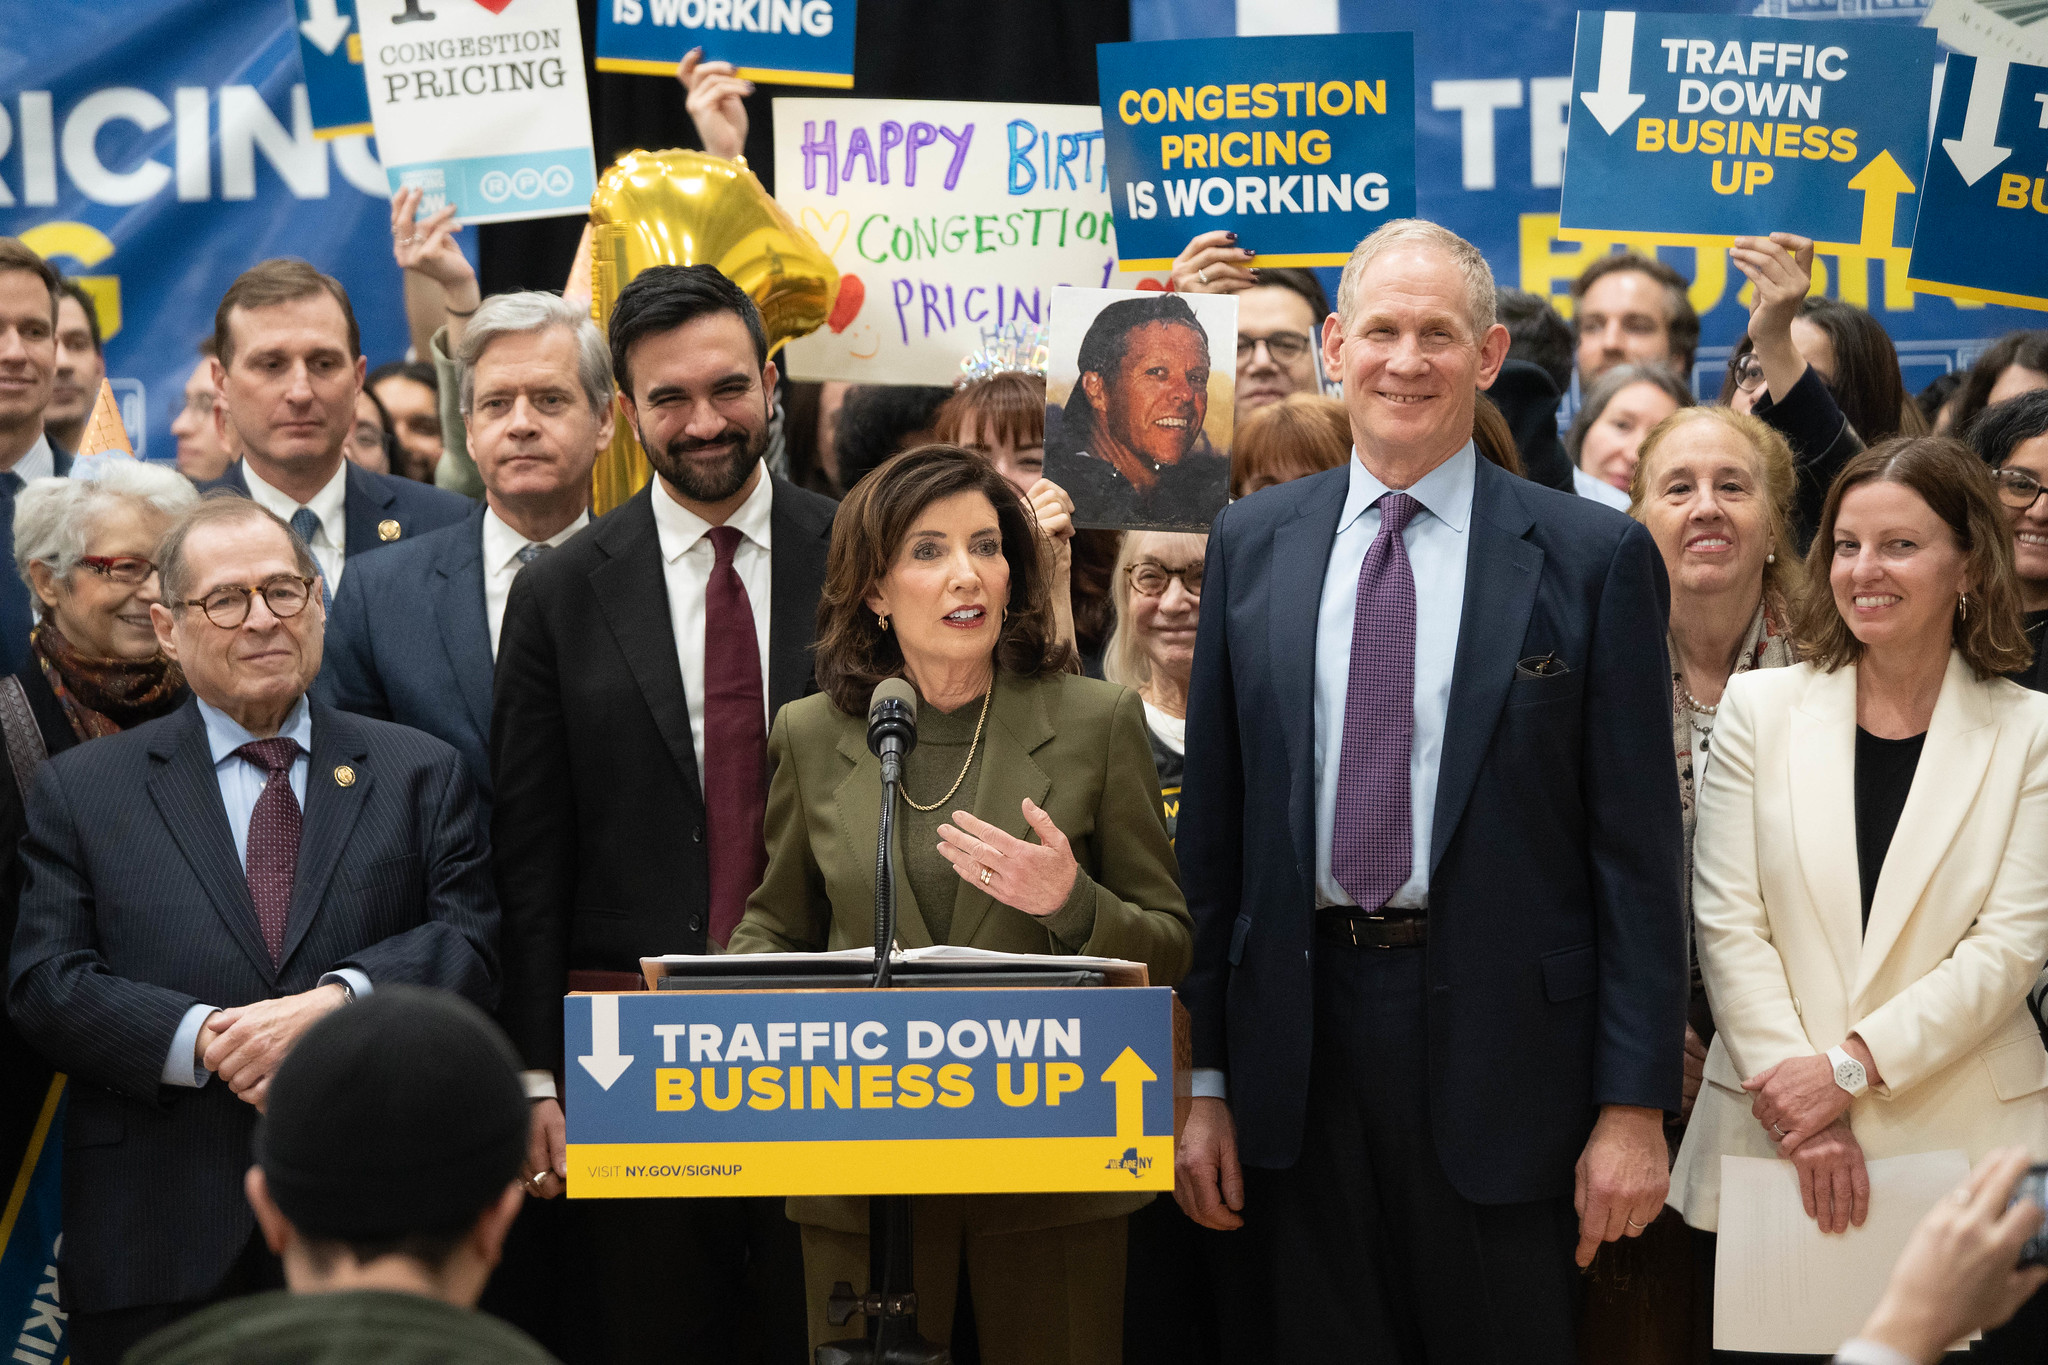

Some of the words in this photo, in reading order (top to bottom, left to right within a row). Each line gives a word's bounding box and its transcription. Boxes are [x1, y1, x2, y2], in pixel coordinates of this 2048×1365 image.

[613, 0, 643, 25] IS
[649, 0, 833, 37] WORKING
[380, 28, 561, 66] CONGESTION
[1661, 38, 1848, 82] TRAFFIC
[384, 57, 566, 104] PRICING
[1118, 79, 1386, 125] CONGESTION
[1678, 79, 1821, 119] DOWN
[801, 120, 975, 196] HAPPY
[1161, 130, 1331, 170] PRICING
[1636, 119, 1858, 162] BUSINESS
[1126, 181, 1157, 219] IS
[1163, 172, 1390, 218] WORKING
[1712, 161, 1773, 195] UP
[892, 277, 1072, 345] PRICIN
[653, 1020, 889, 1062] TRAFFIC
[906, 1018, 1081, 1059] DOWN
[655, 1063, 976, 1112] BUSINESS
[996, 1062, 1085, 1107] UP
[588, 1165, 621, 1178] VISIT
[625, 1164, 743, 1178] NY.GOV/SIGNUP
[1138, 1156, 1153, 1169] NY
